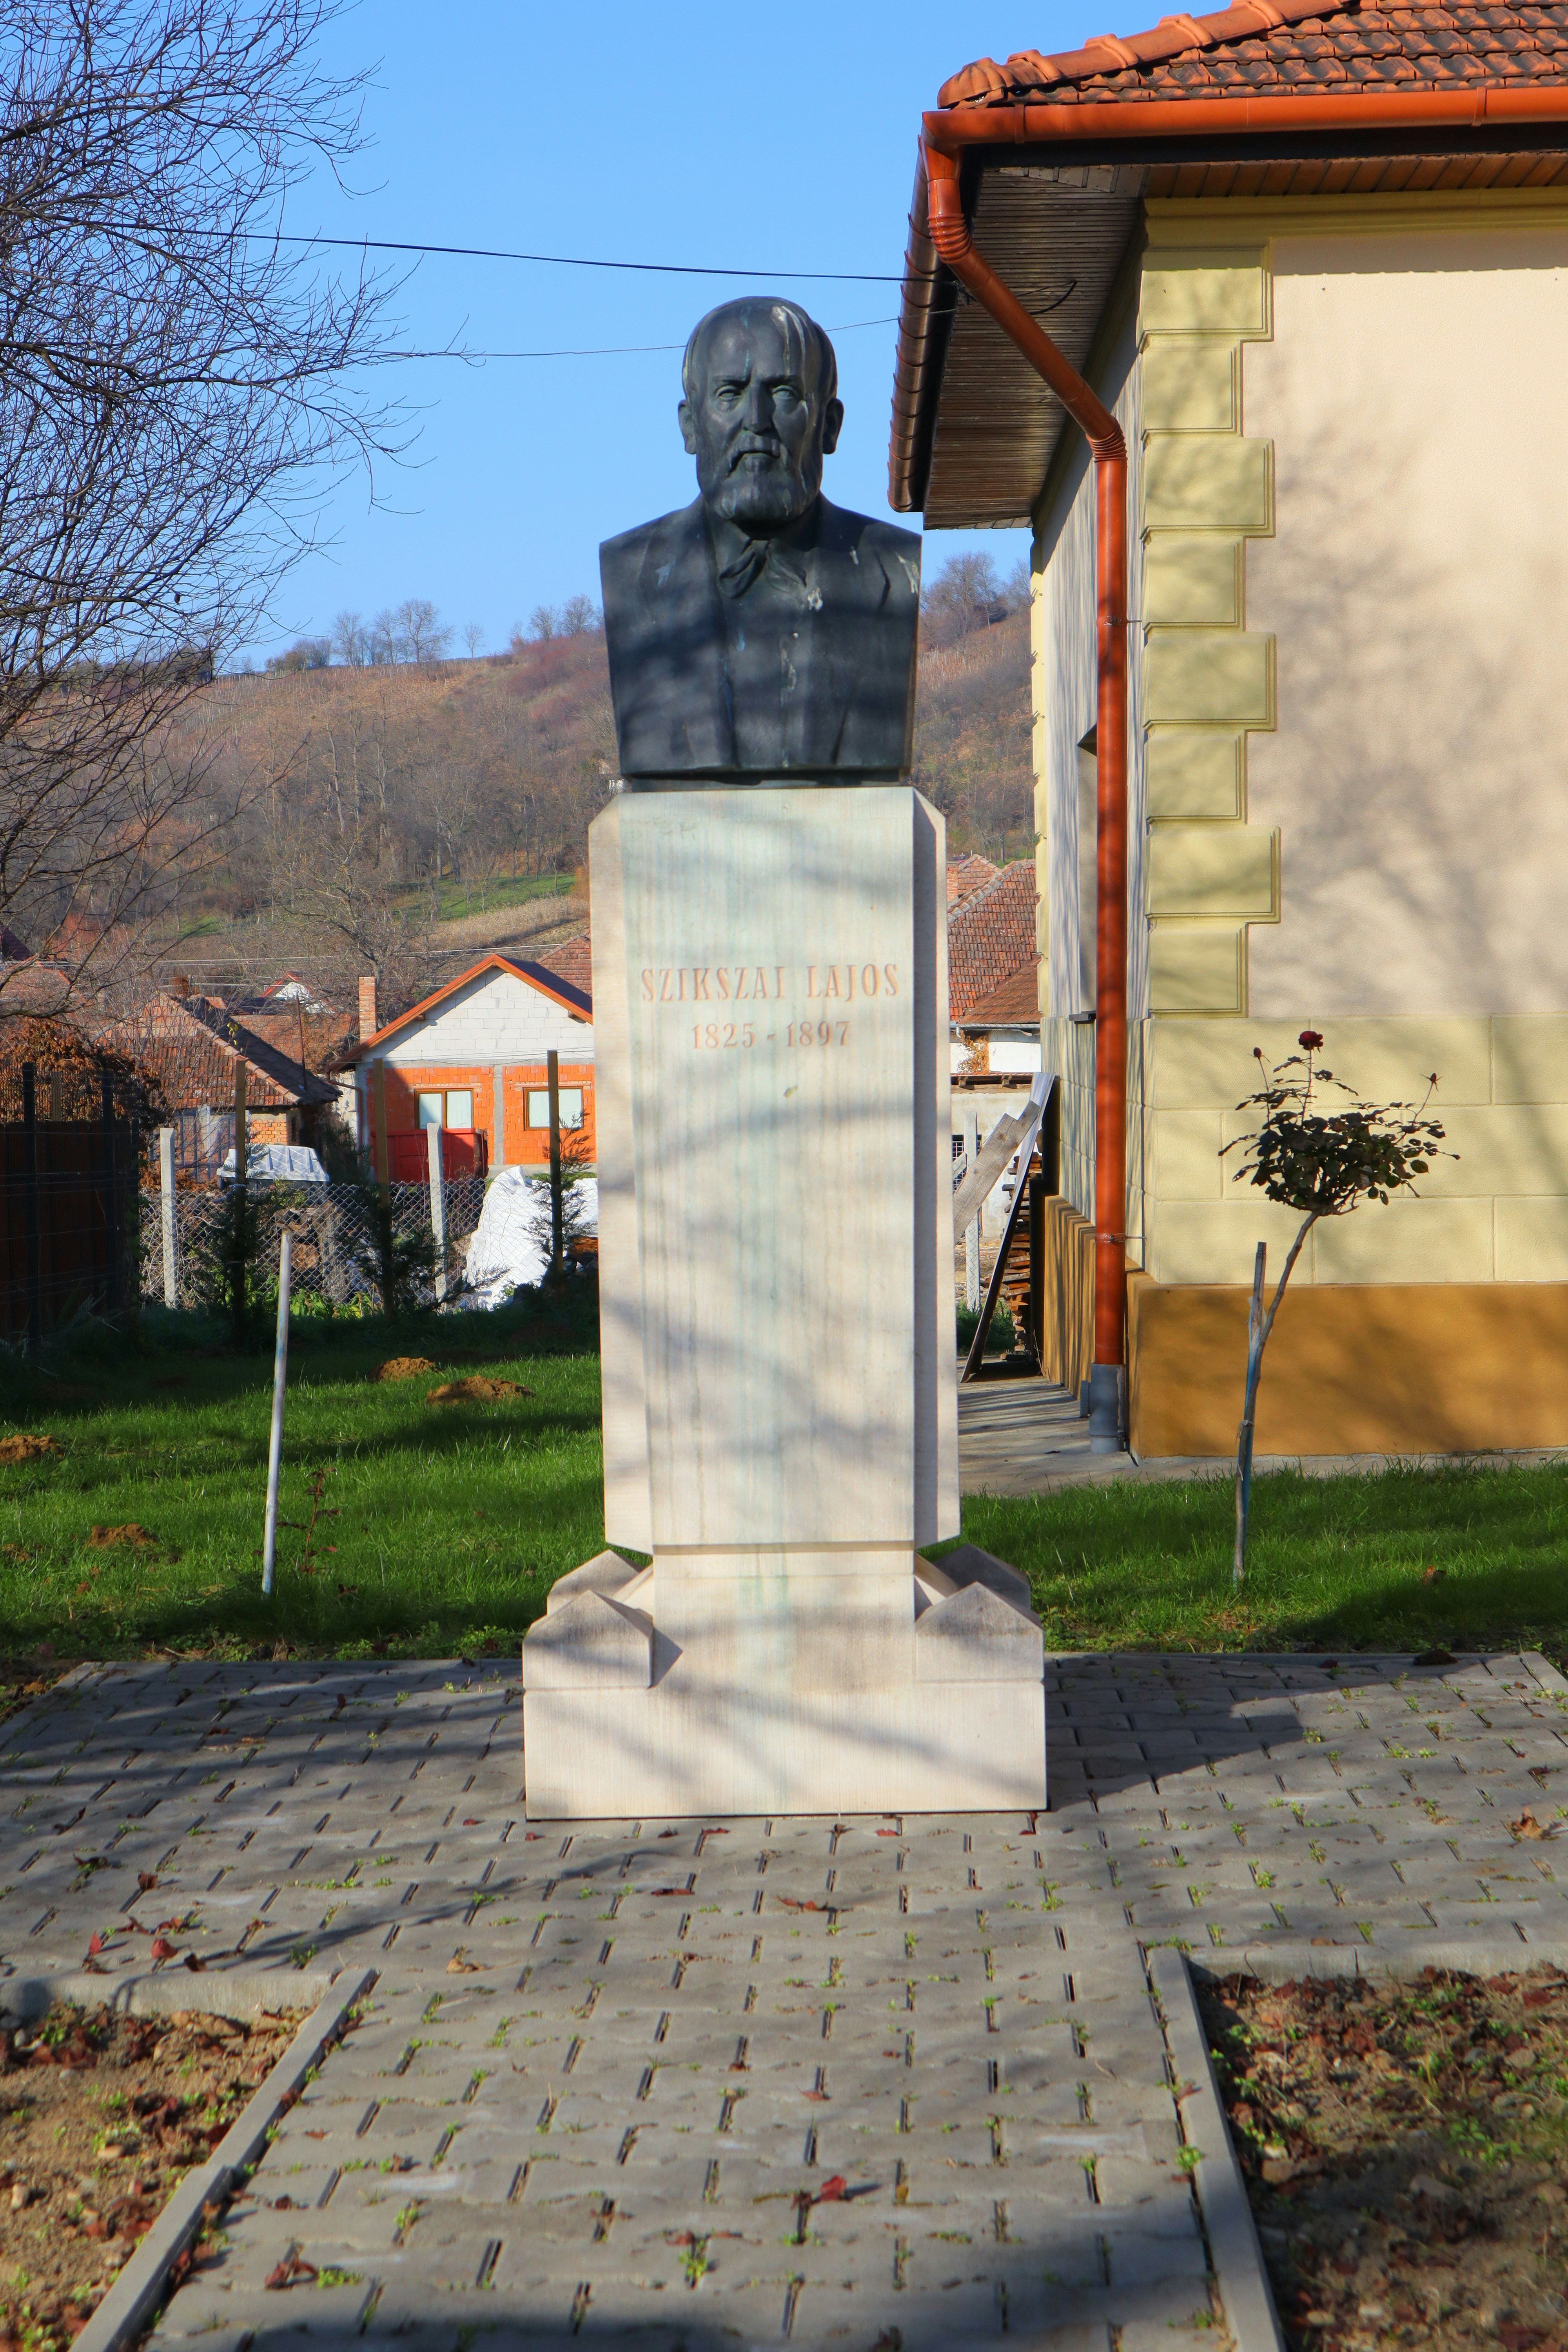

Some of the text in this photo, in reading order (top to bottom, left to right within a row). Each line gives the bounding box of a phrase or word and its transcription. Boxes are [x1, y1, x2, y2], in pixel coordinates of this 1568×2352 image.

[641, 963, 899, 1002] SZIKSZAI LAJOS
[691, 1022, 756, 1049] 1825
[786, 1020, 851, 1047] 1897
